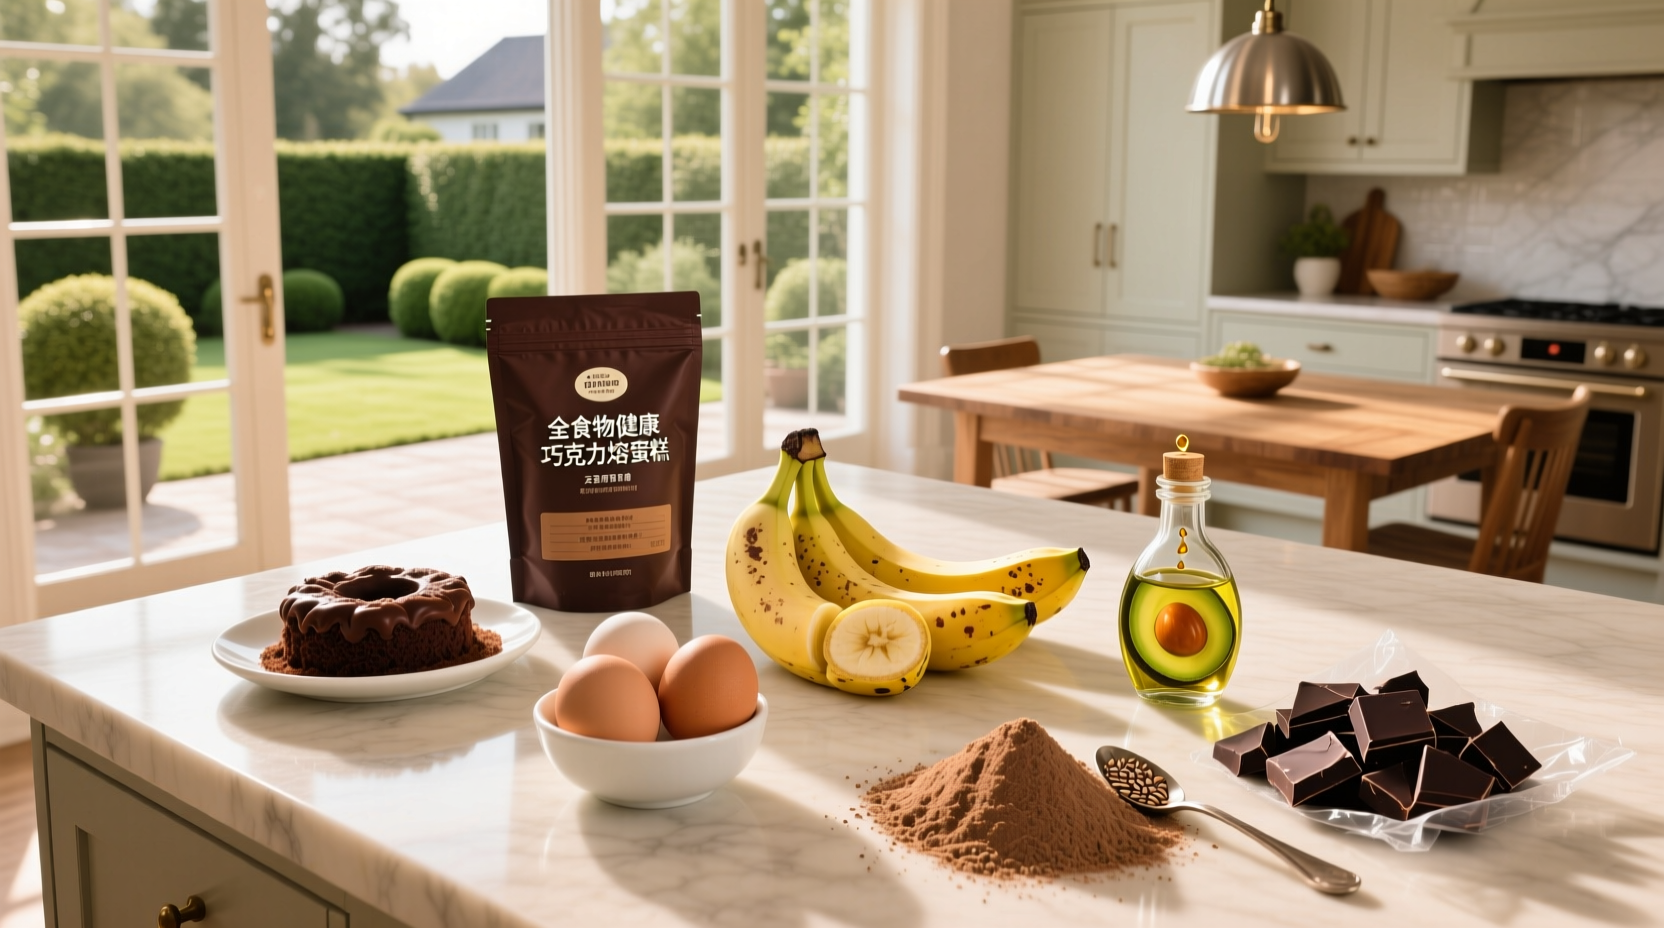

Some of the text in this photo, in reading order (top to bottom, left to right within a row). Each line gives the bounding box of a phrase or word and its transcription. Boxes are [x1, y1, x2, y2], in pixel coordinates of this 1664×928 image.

[547, 412, 660, 440] 全食物健康
